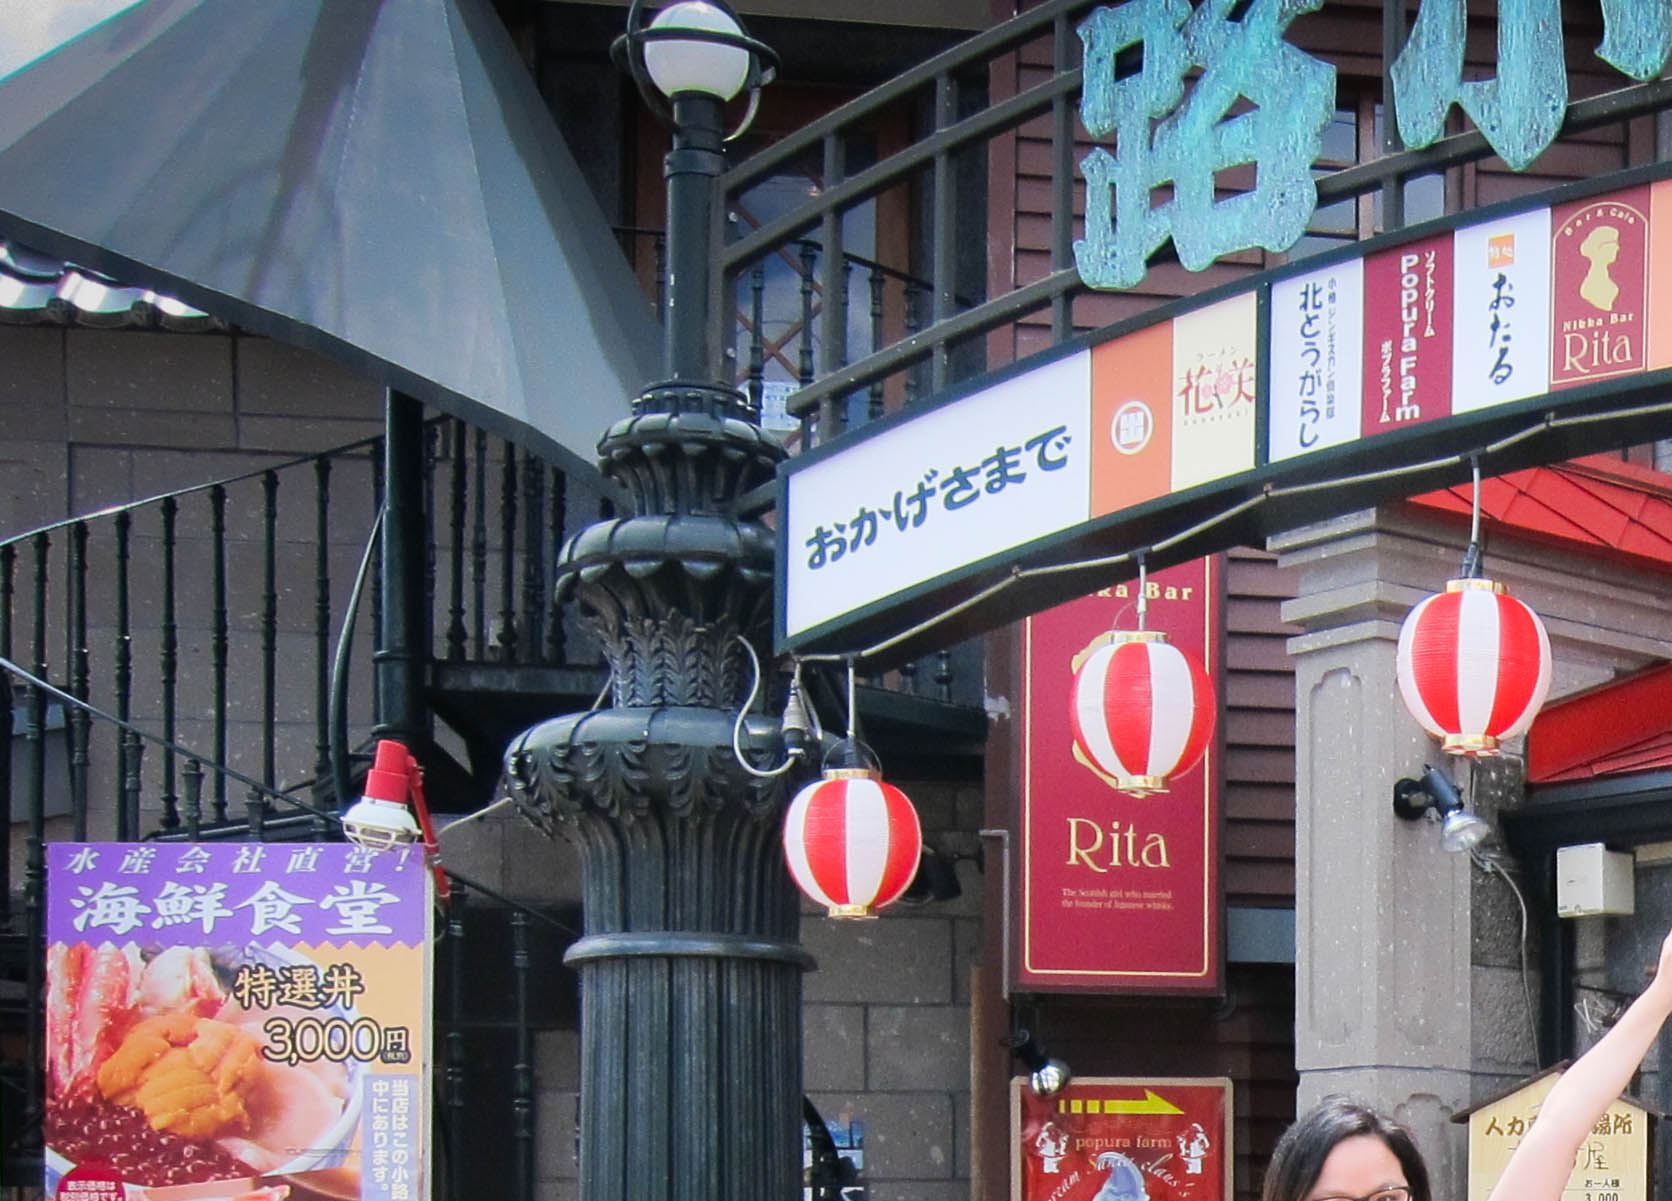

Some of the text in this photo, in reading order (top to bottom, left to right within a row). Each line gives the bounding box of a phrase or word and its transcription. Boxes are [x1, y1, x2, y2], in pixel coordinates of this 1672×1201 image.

[1424, 251, 1436, 338] ソフトクリーム
[1610, 312, 1635, 325] Bar
[1489, 272, 1516, 385] おたる
[1563, 331, 1633, 373] Rita
[1299, 282, 1323, 448] 北とうがらし
[805, 425, 1072, 570] おかげさまで
[1145, 582, 1193, 600] Bar
[1066, 818, 1171, 873] Rita
[69, 880, 401, 937] 海鮮食堂
[234, 963, 364, 1010] 特選丼
[262, 1017, 409, 1066] 3,000円
[372, 1080, 389, 1191] 中にあります。
[1076, 1135, 1172, 1150] popura farm
